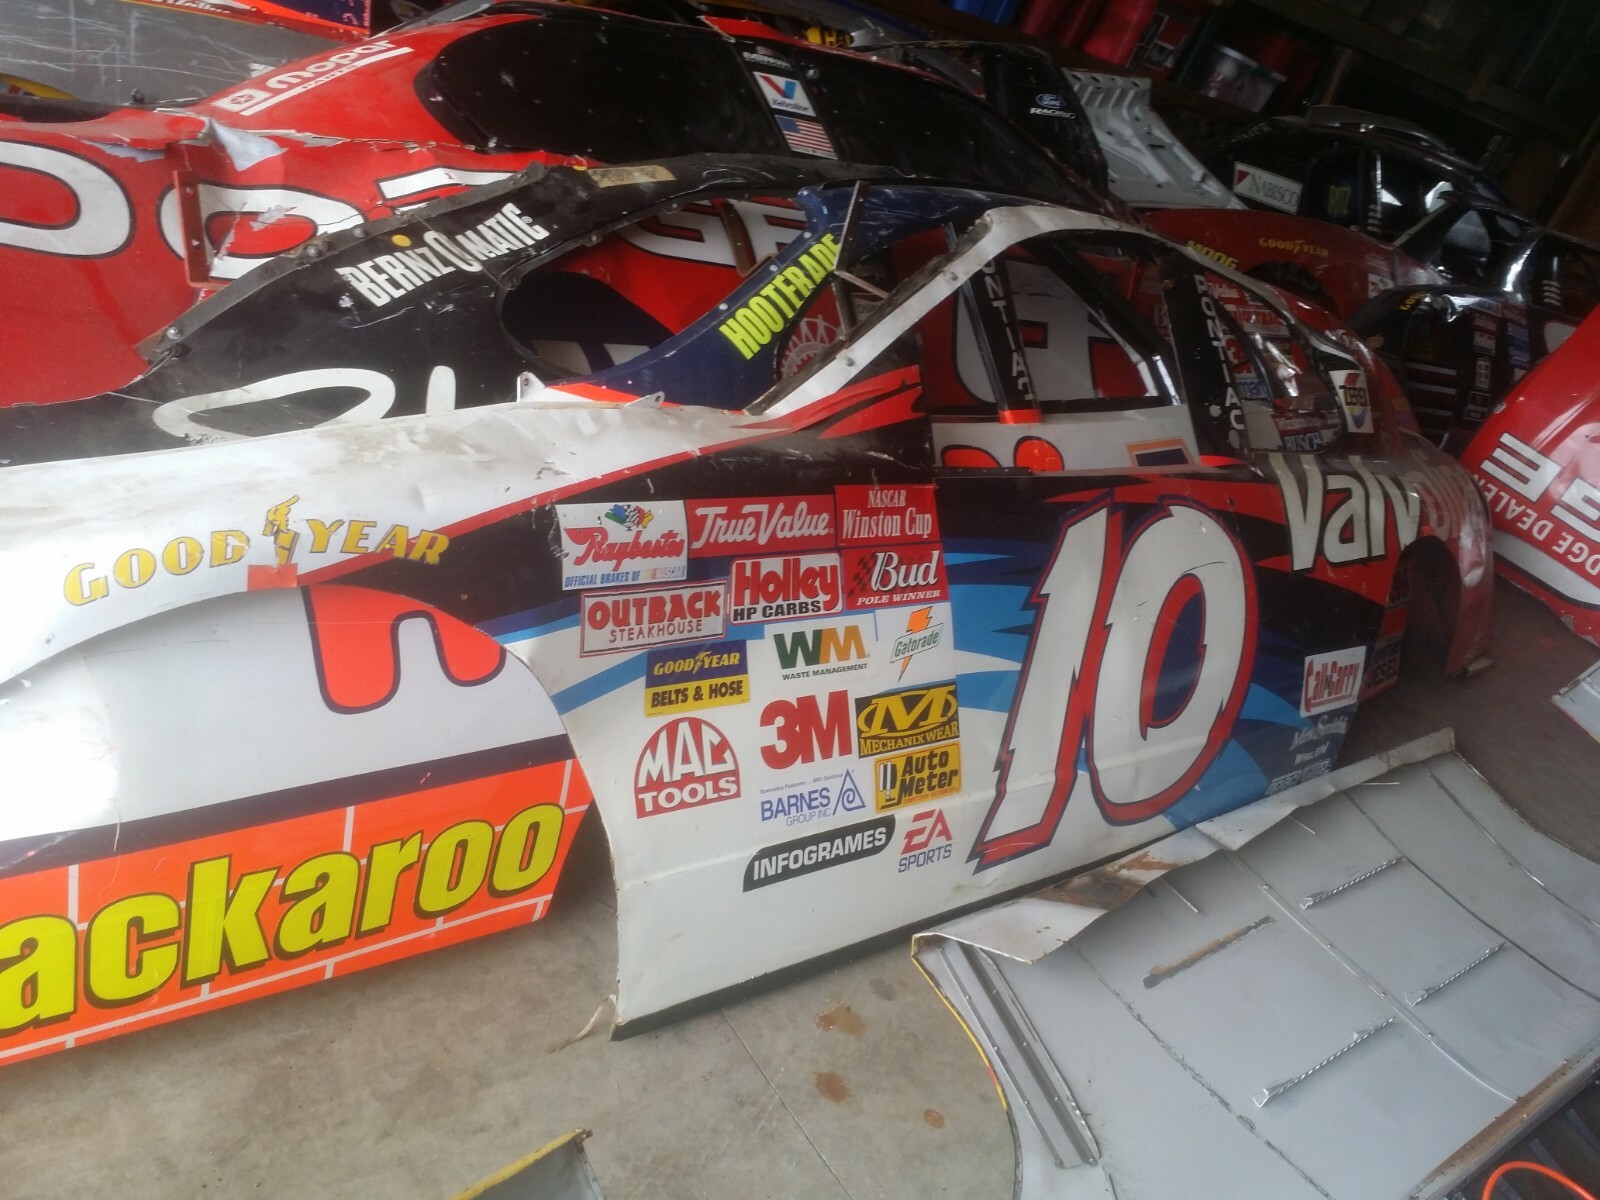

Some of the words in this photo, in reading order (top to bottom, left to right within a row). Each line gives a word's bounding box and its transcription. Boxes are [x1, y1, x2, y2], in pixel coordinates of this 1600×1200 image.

[266, 39, 397, 89] mopar
[719, 233, 843, 360] HOOTERADE
[1194, 273, 1245, 430] PONTIAC
[867, 489, 906, 508] NASCAR
[842, 510, 901, 539] Winston
[904, 507, 932, 538] Cup
[565, 573, 598, 588] OFFICIAL
[600, 571, 630, 585] BRAKES
[632, 570, 641, 582] OF
[733, 558, 839, 612] Holley
[871, 550, 939, 591] Bud
[587, 590, 722, 631] OUTBACK
[733, 606, 757, 621] HP
[762, 600, 821, 619] CARBS
[856, 595, 889, 606] POLE
[893, 589, 941, 602] WINNER
[609, 618, 703, 644] STEAKHOUSE
[773, 625, 867, 670] WM
[894, 630, 940, 657] Gatorade
[782, 671, 811, 681] WASTE
[812, 663, 867, 677] MANAGEMENT
[967, 494, 1259, 872] 10
[651, 687, 689, 709] BELTS
[693, 686, 703, 701] &
[709, 680, 743, 701] HOSE
[760, 689, 853, 770] 3M
[860, 735, 925, 757] MECHANIX
[926, 721, 960, 742] WEAR
[638, 720, 736, 788] MAC
[902, 750, 949, 777] Auto
[638, 776, 738, 813] TOOLS
[900, 769, 959, 798] Meter
[760, 787, 831, 822] BARNES
[786, 811, 816, 827] GROUP
[818, 808, 832, 820] INC
[900, 808, 953, 856] EA
[753, 827, 887, 881] INFOGRAMES
[898, 844, 953, 873] SPORTS
